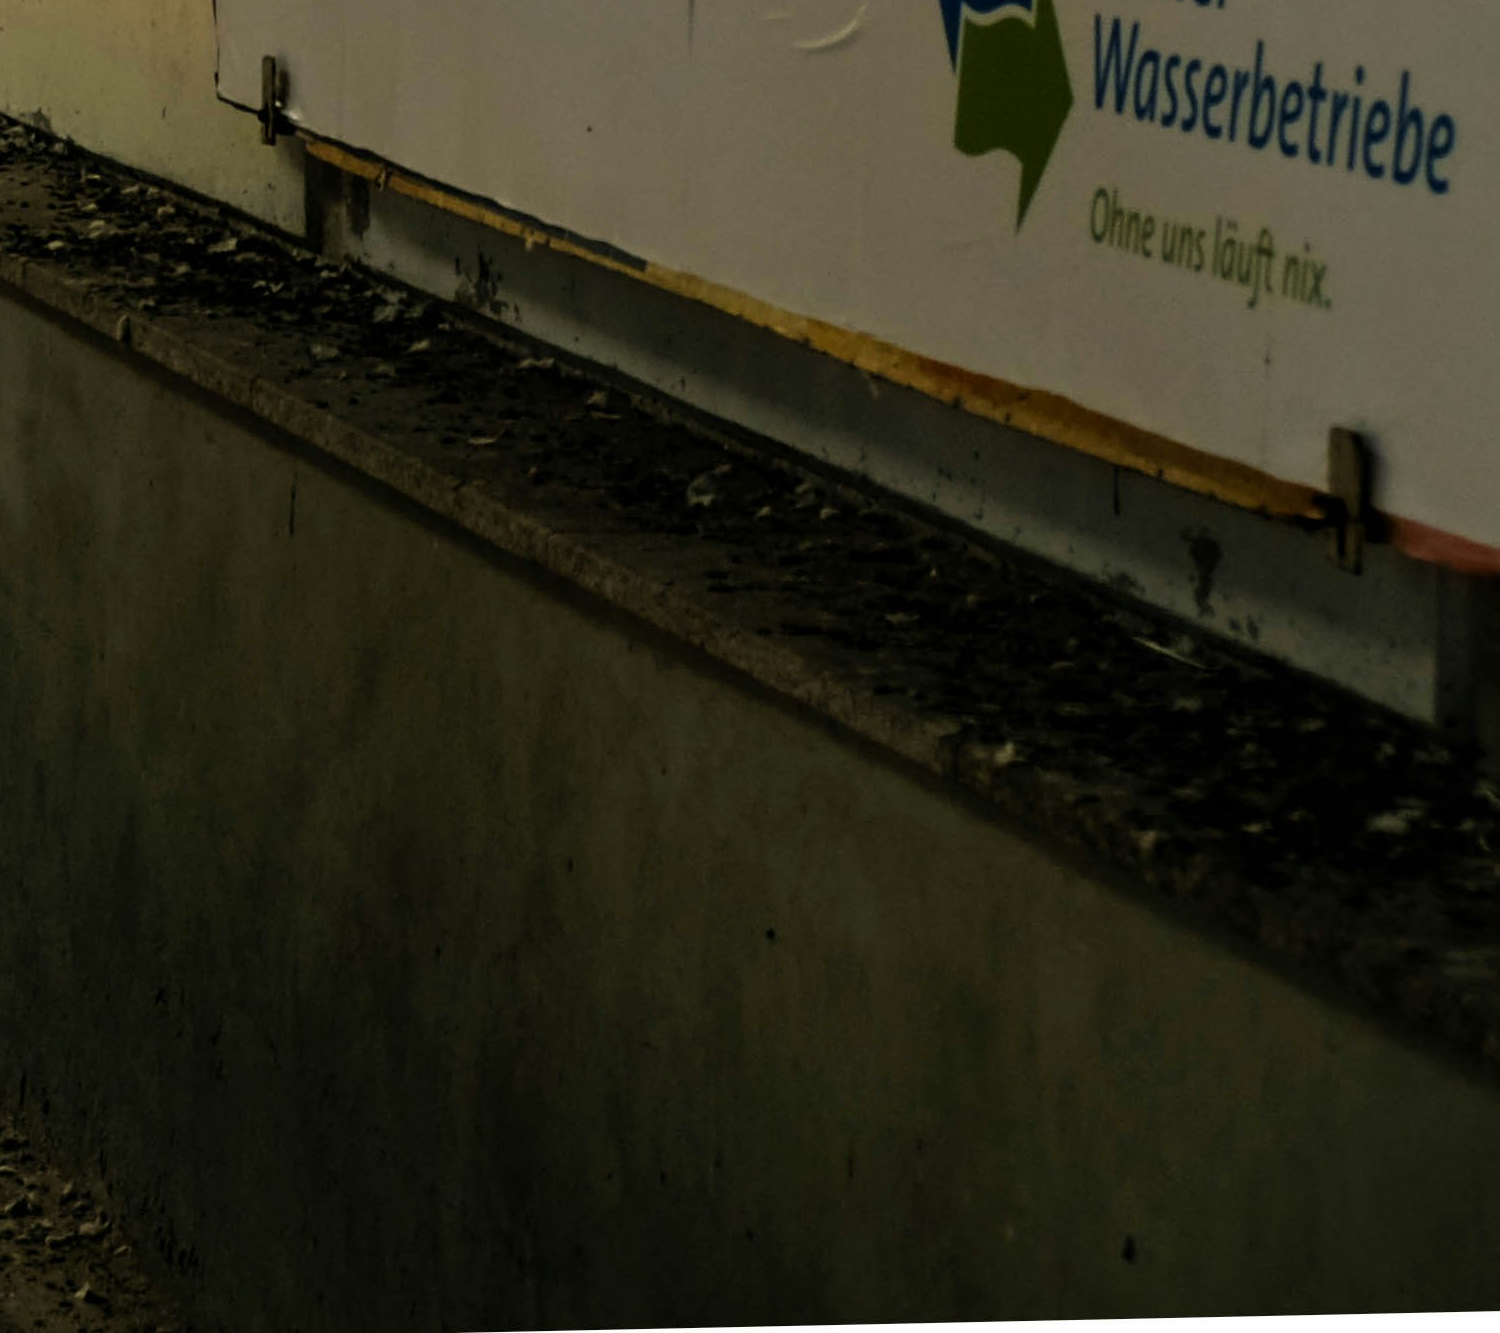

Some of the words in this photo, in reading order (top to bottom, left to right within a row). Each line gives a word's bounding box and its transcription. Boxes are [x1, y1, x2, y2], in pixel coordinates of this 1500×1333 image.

[1094, 13, 1456, 196] Wasserbetriebe
[1090, 186, 1155, 260] Ohne
[1162, 220, 1205, 273] uns
[1212, 216, 1276, 310] läuft
[1282, 241, 1333, 310] nix.
